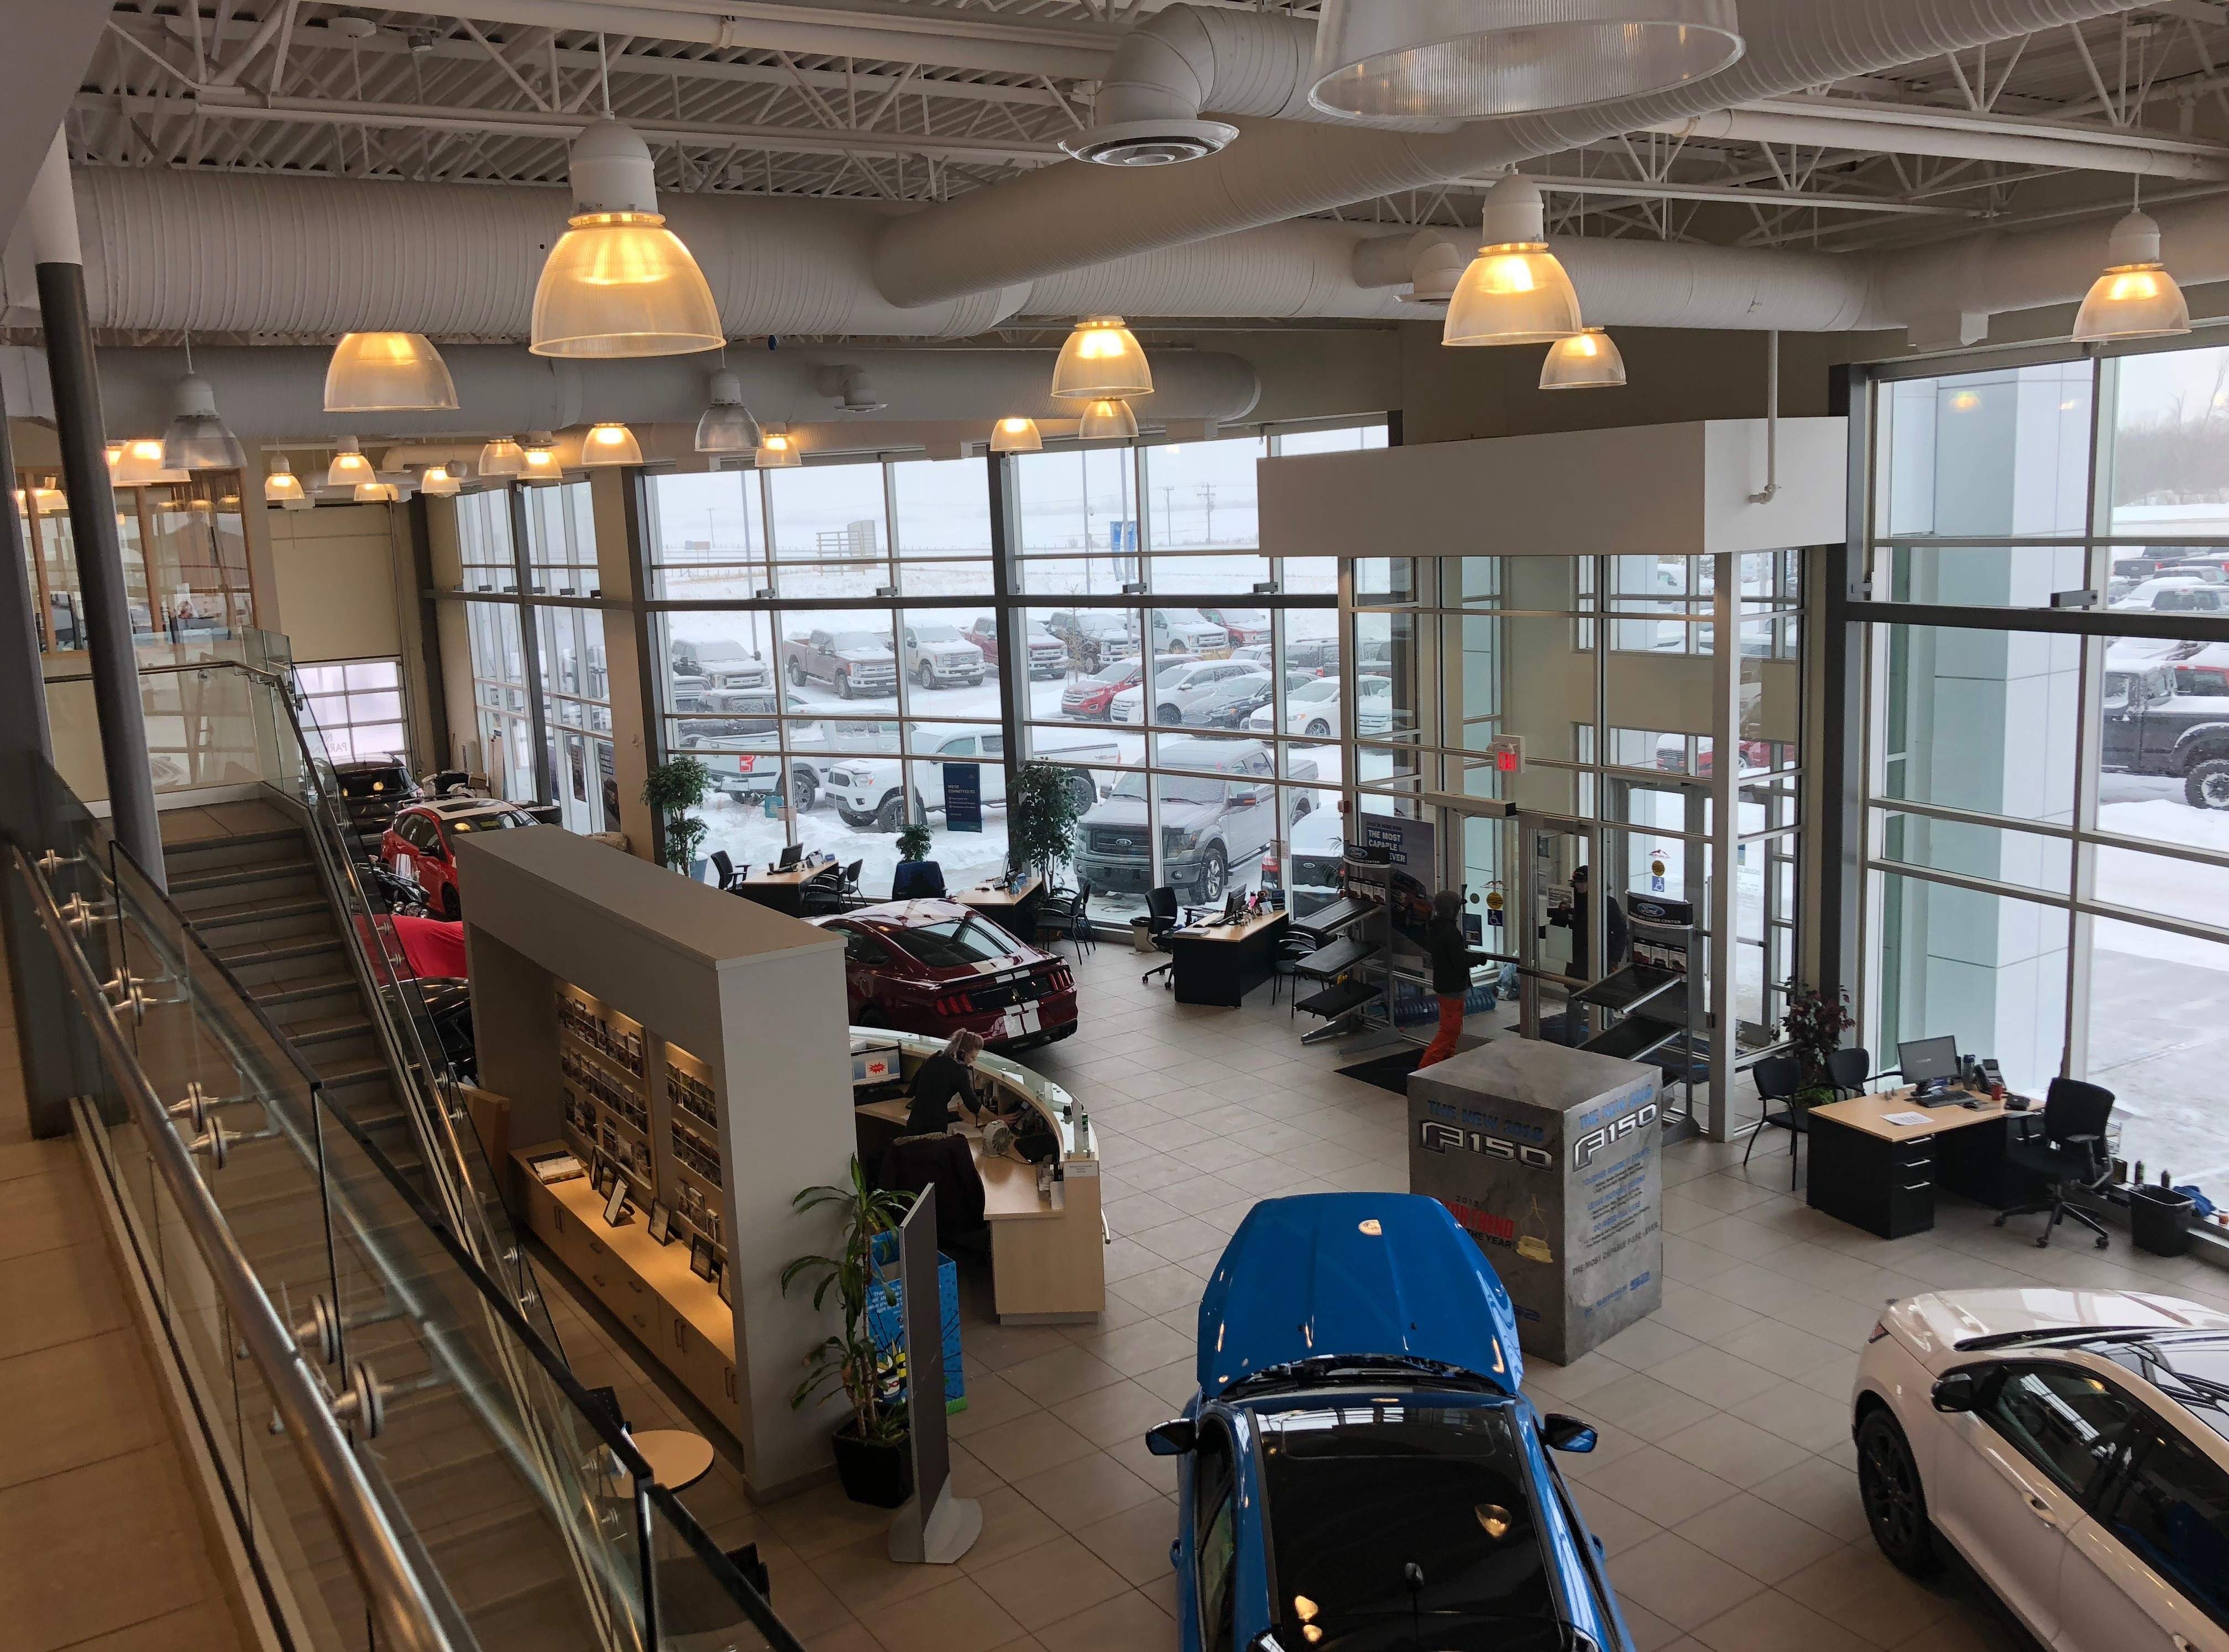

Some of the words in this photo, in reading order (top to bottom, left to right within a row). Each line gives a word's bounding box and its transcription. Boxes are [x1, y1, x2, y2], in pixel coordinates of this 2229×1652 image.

[1499, 751, 1517, 770] EXIT
[1368, 829, 1380, 838] THE
[1382, 832, 1401, 841] MOST
[1428, 1100, 1457, 1121] THE
[1462, 1109, 1498, 1130] NEW
[1579, 1109, 1599, 1130] THE
[1603, 1096, 1626, 1118] NEW
[1466, 1228, 1484, 1241] THE
[1486, 1233, 1513, 1249] YEAR
